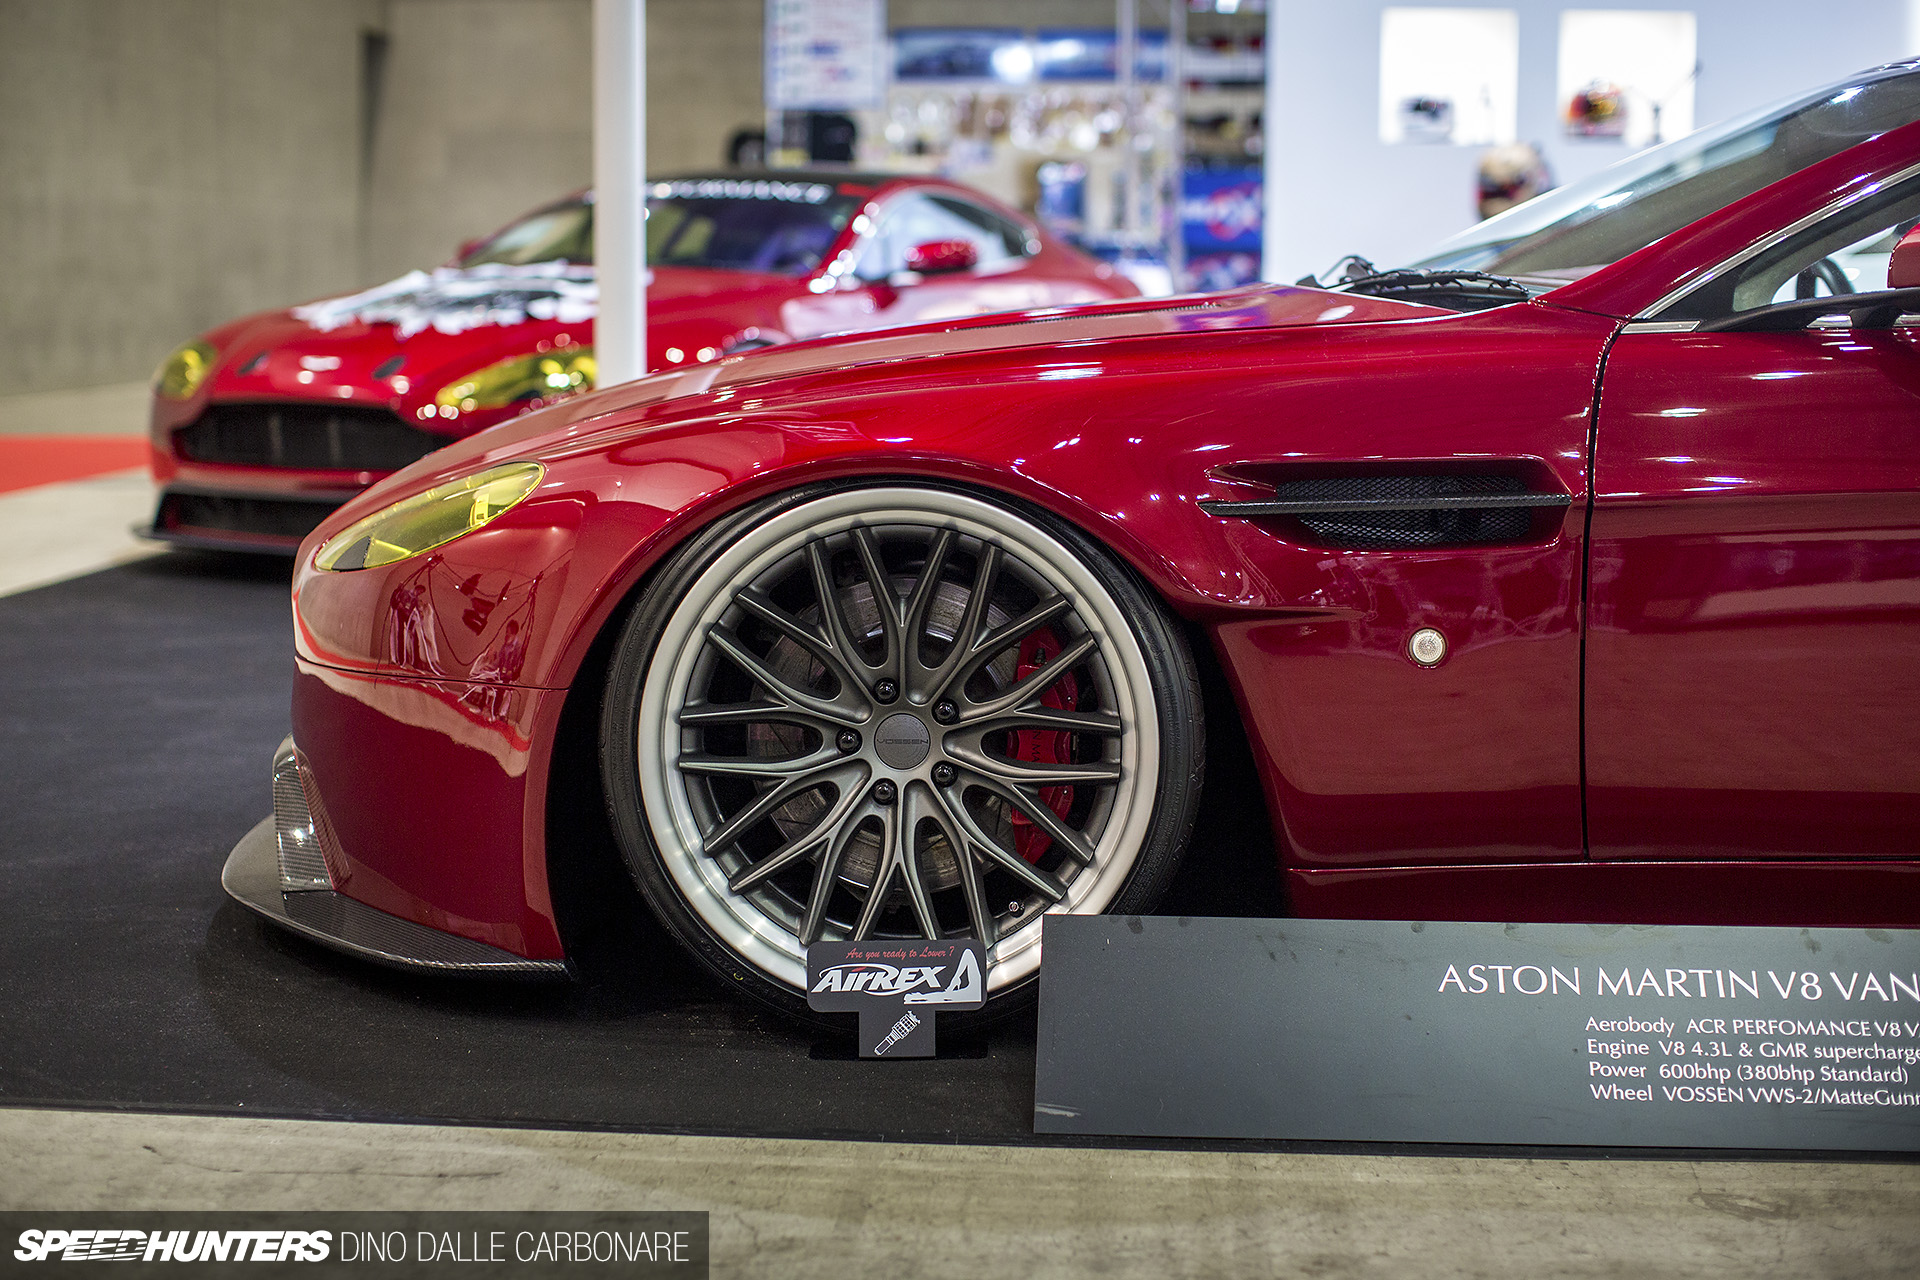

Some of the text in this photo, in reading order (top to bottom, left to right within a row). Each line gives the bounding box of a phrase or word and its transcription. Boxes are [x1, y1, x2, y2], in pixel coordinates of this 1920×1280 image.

[845, 947, 863, 959] Are
[865, 950, 881, 960] you
[883, 948, 907, 960] ready
[909, 947, 917, 957] to
[1438, 963, 1920, 1002] ASTON MARTIN V8 VAN
[1584, 1016, 1676, 1037] Aerobody
[1686, 1018, 1727, 1034] ACR
[1733, 1019, 1872, 1037] PERFOMANCE
[1874, 1021, 1902, 1037] V8
[1587, 1039, 1649, 1060] Engine
[1658, 1041, 1686, 1056] V8
[1691, 1041, 1732, 1057] 4.3L
[1739, 1042, 1754, 1057] &
[1759, 1042, 1809, 1058] GMR
[1589, 1061, 1908, 1085] Power 600bhp (380bhp Standard)
[1590, 1083, 1653, 1101] Wheel
[1662, 1085, 1744, 1102] VOSSEN
